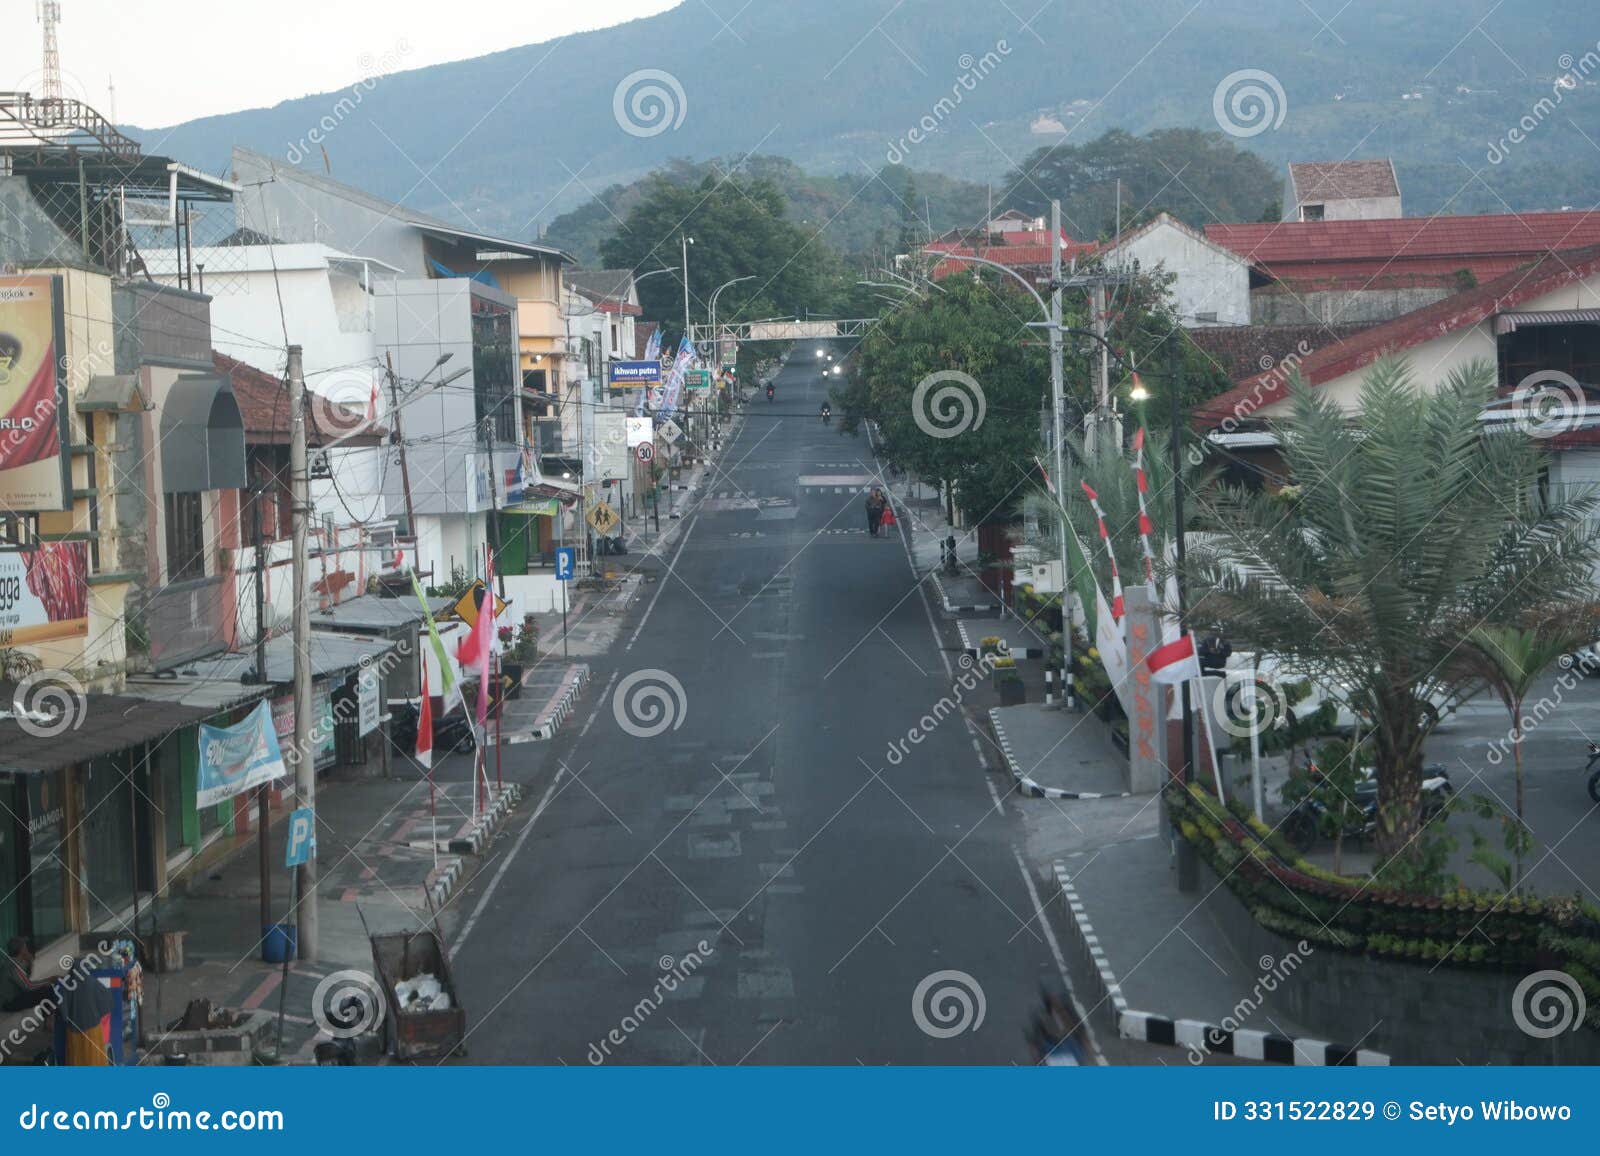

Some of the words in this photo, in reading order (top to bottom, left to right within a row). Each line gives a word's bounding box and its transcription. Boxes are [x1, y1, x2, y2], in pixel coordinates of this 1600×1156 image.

[614, 367, 638, 375] ikhwan
[639, 367, 657, 376] putra
[640, 449, 651, 459] 30
[559, 552, 569, 575] P
[290, 817, 308, 858] P
